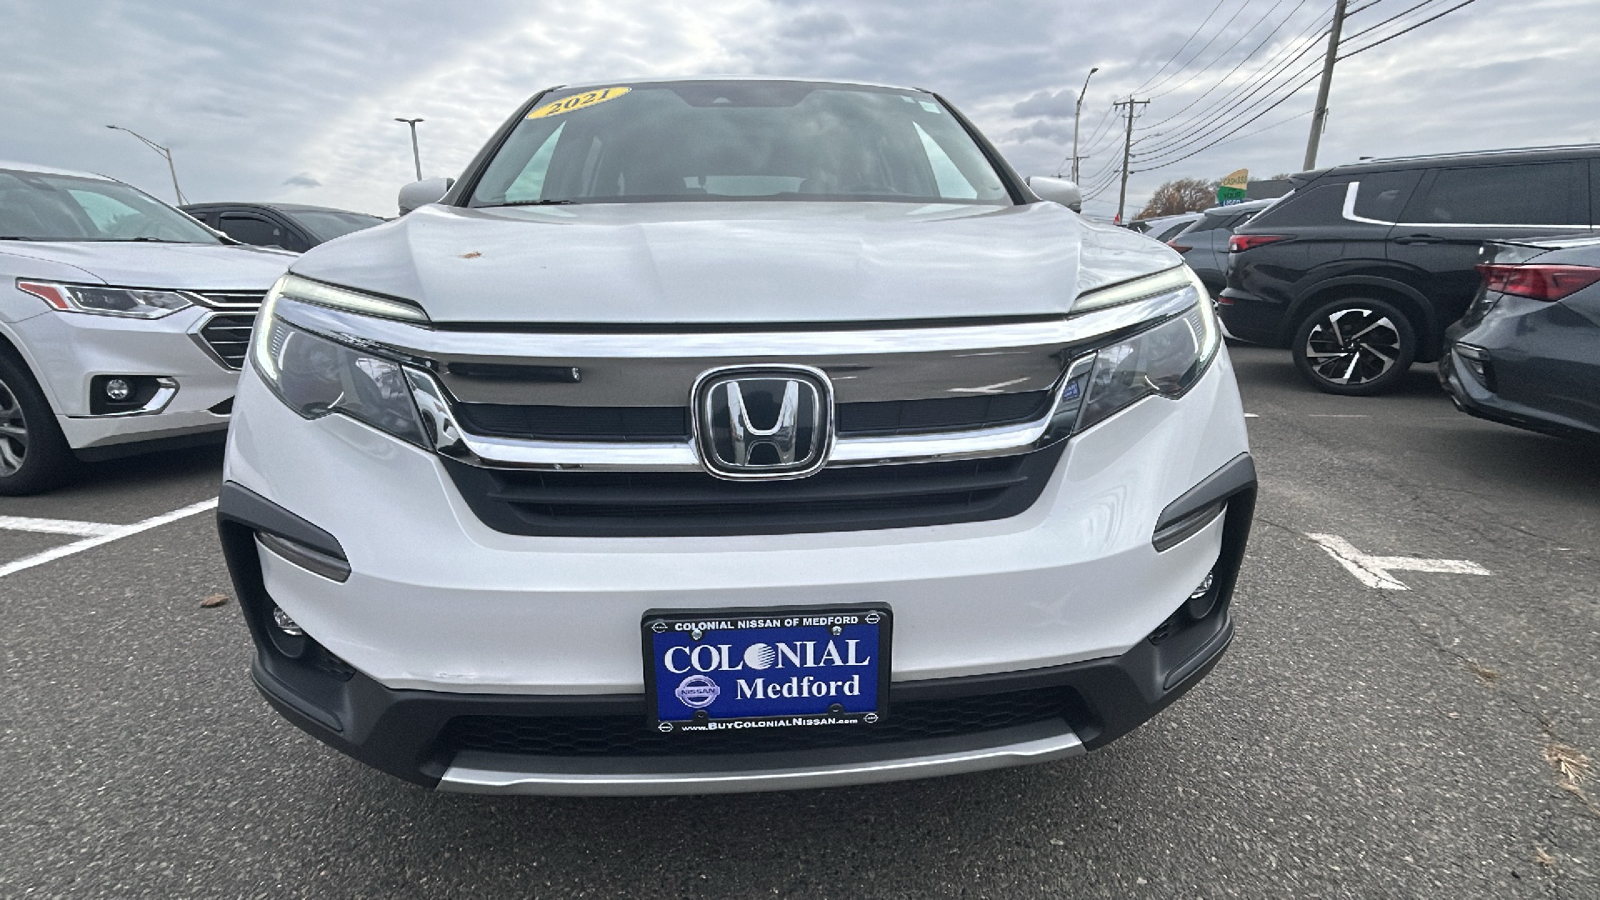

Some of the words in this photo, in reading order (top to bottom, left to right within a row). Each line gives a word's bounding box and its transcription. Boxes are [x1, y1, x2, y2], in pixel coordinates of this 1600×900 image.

[546, 89, 610, 115] 2021
[674, 620, 735, 632] COLONIAL
[737, 618, 781, 630] NISSAN
[784, 617, 800, 627] OF
[802, 615, 859, 627] MEDFORD
[664, 639, 871, 674] COLONIAL
[681, 686, 716, 696] NISSAN
[735, 674, 861, 700] Medford
